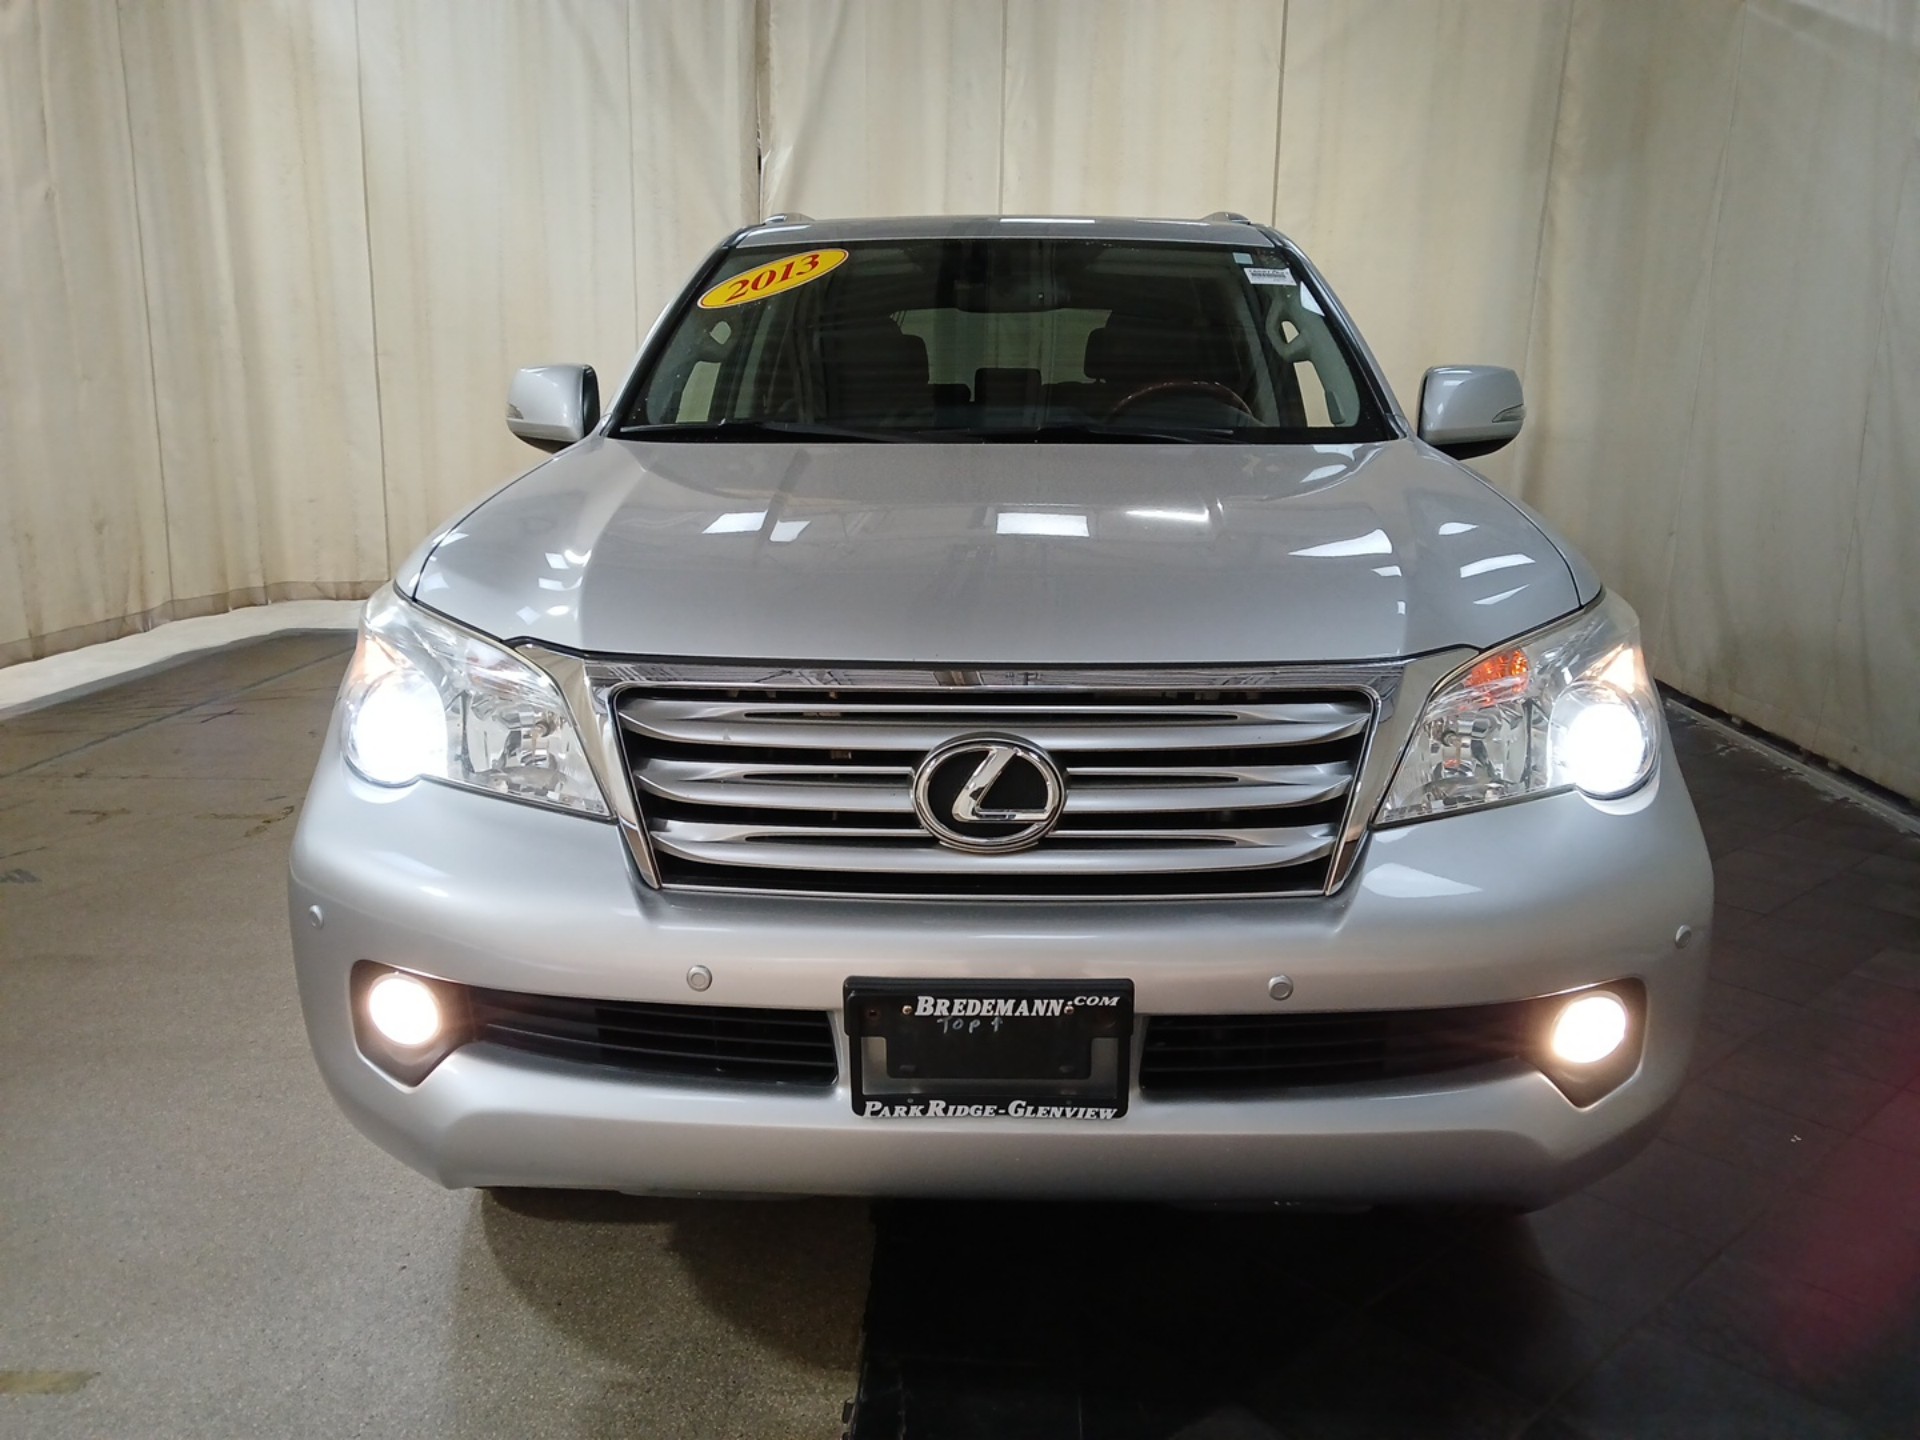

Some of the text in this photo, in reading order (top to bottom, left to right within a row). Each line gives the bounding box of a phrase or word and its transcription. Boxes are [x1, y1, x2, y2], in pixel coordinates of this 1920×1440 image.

[724, 253, 821, 304] 2013
[863, 1099, 1118, 1121] PARK RIDGE-GLENVIEW
